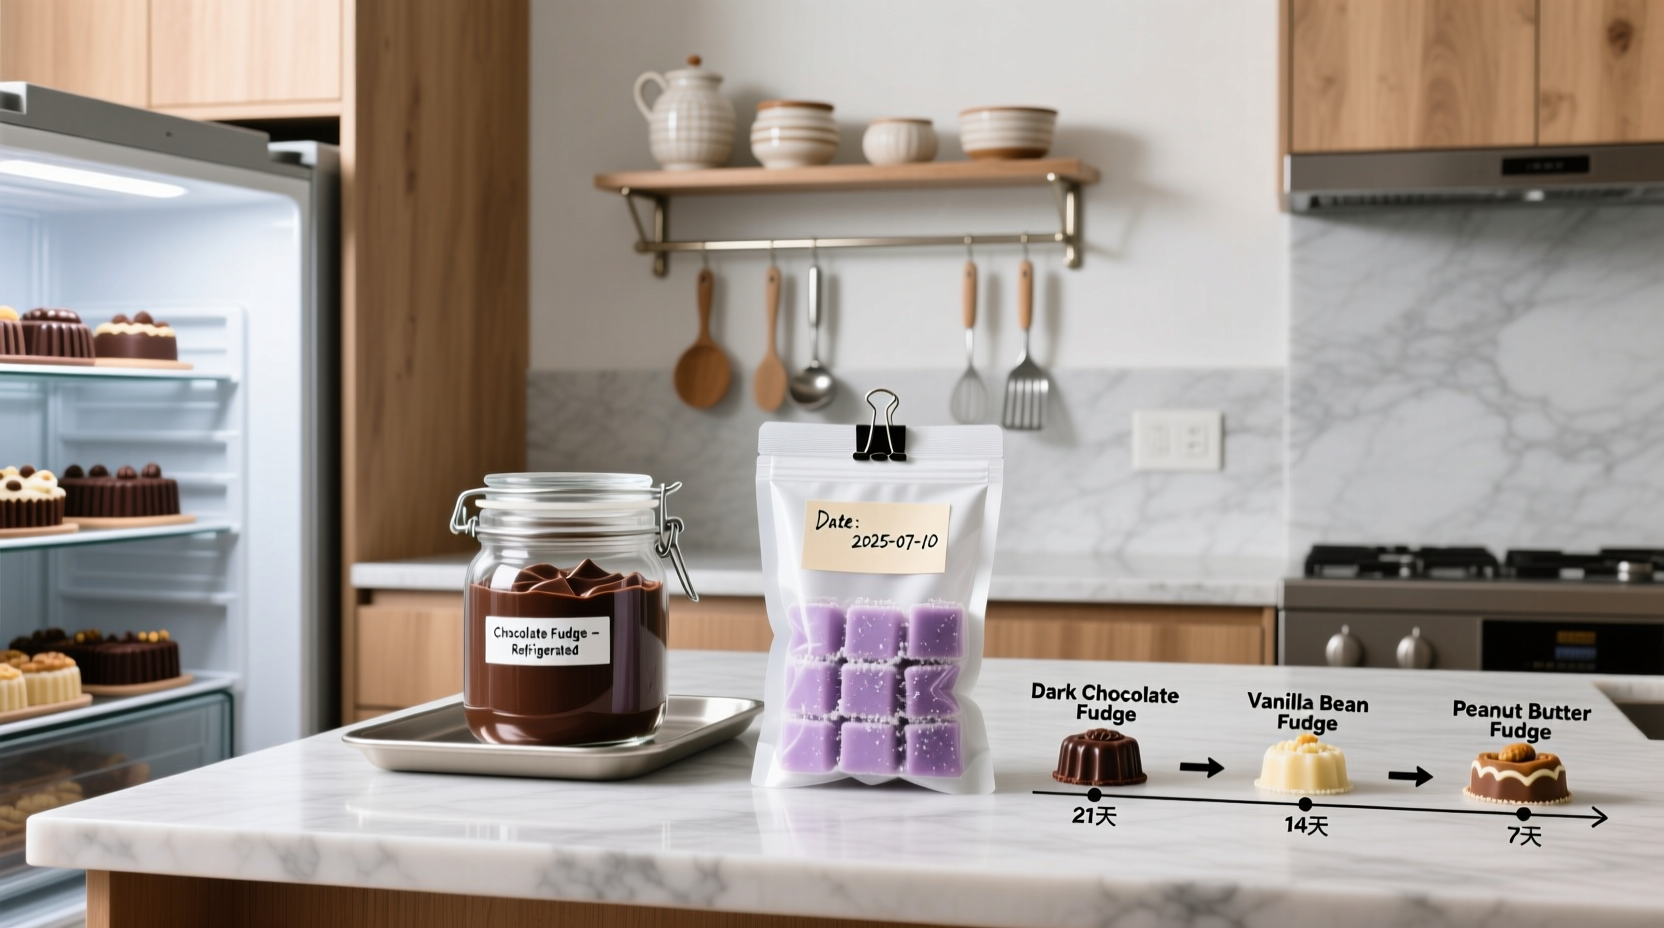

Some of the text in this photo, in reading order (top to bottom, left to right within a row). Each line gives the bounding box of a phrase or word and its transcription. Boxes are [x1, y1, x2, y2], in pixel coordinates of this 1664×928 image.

[815, 509, 859, 530] Date:
[851, 533, 938, 550] 2025-07-10
[493, 626, 548, 639] Chocolate
[550, 626, 588, 642] Fudge
